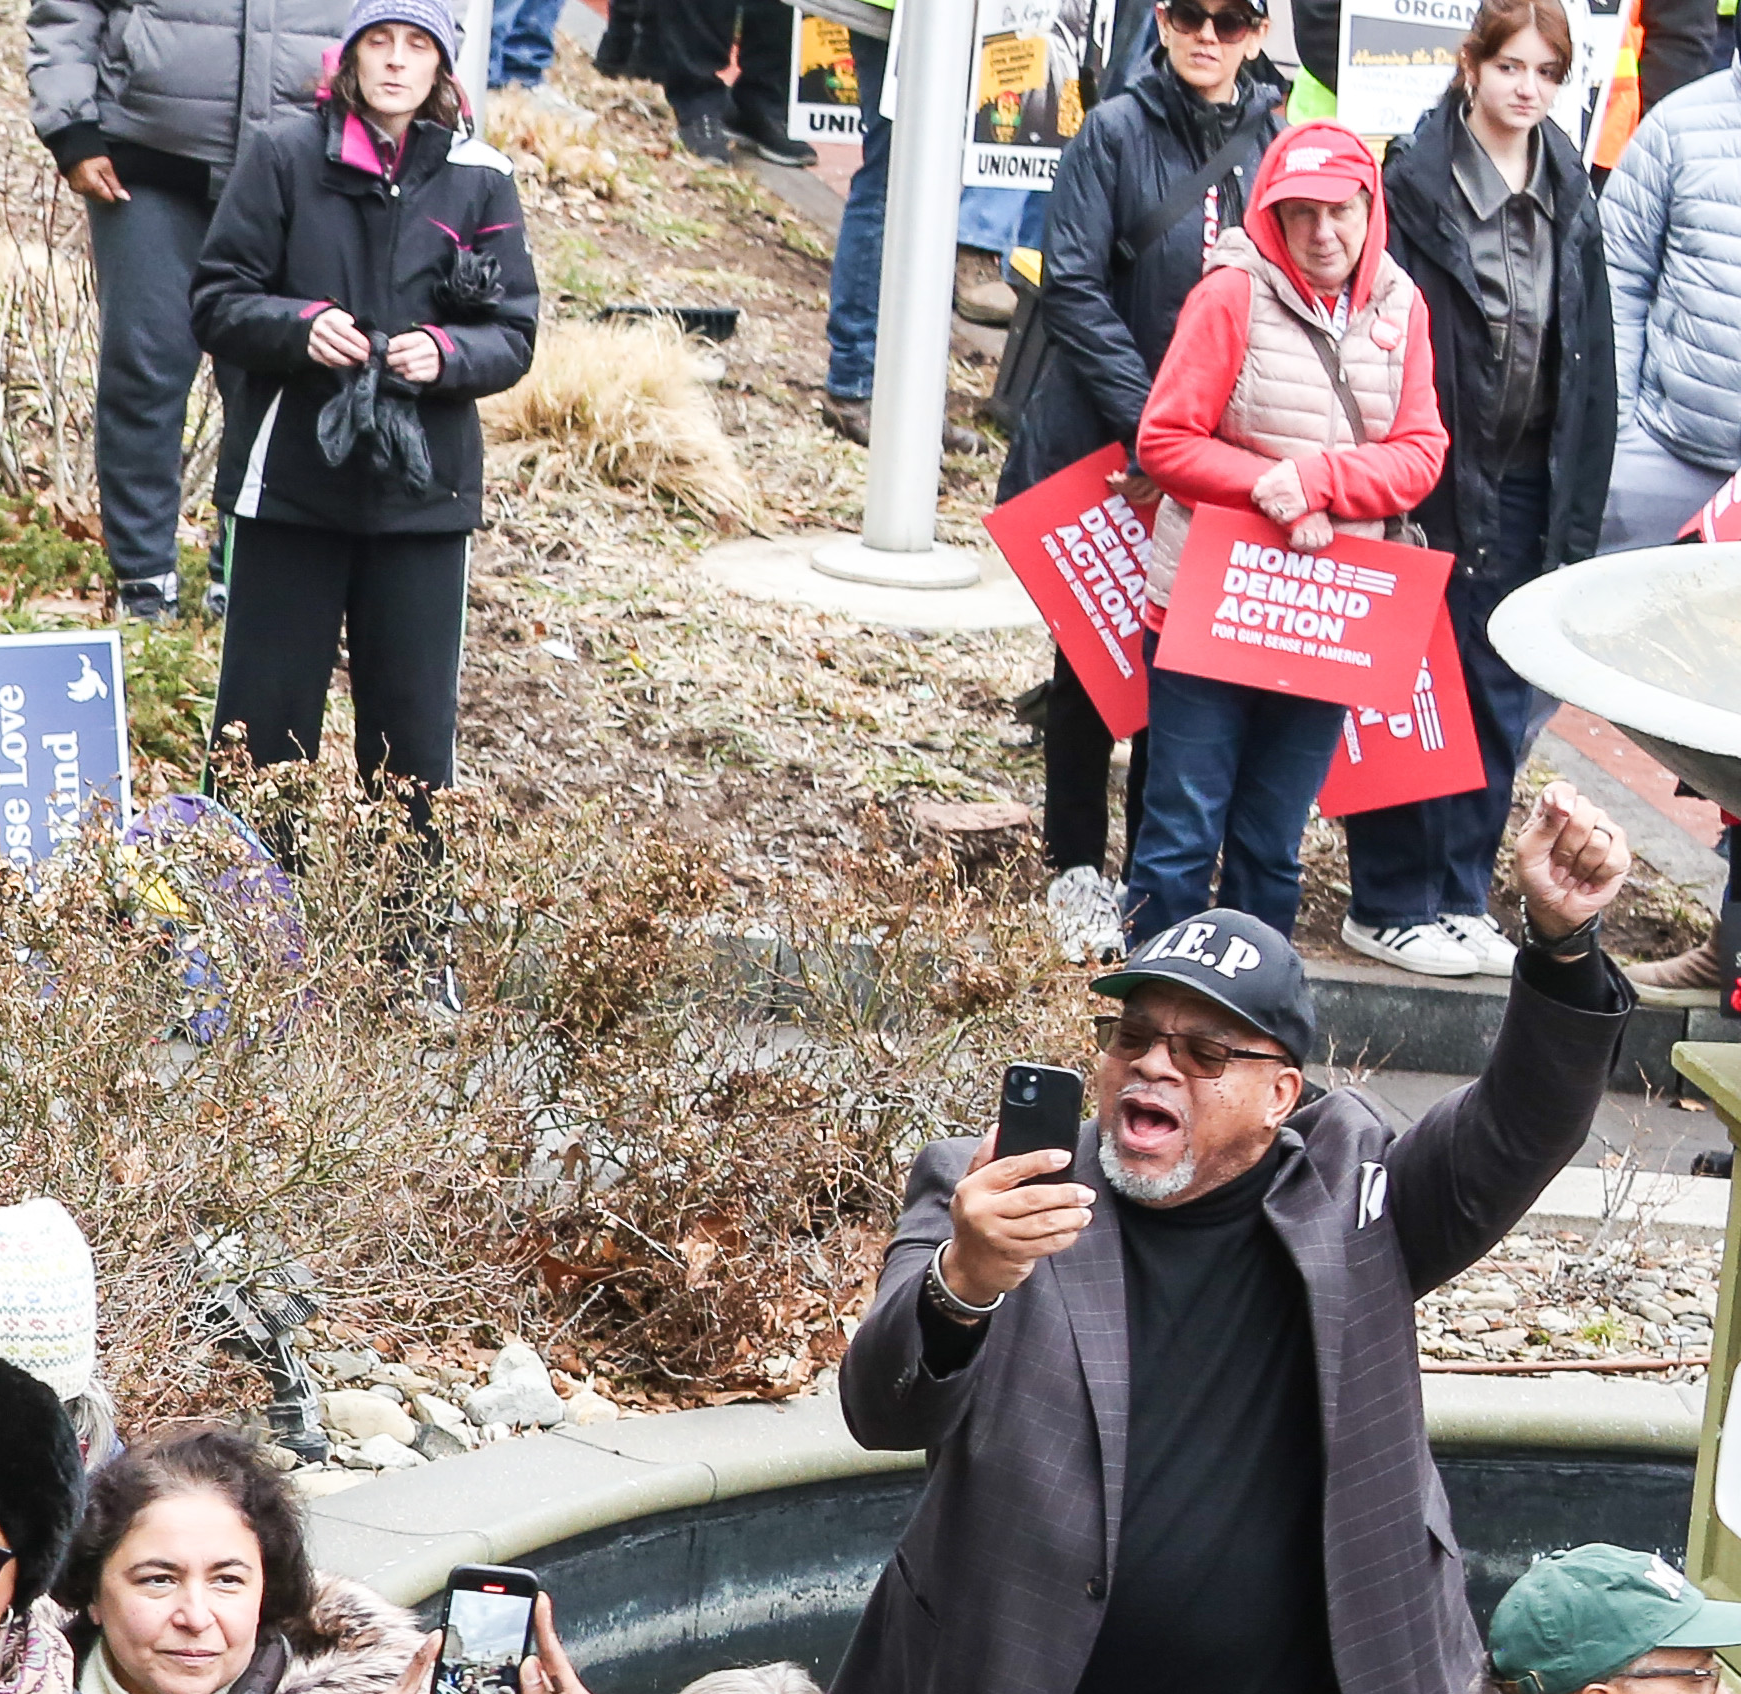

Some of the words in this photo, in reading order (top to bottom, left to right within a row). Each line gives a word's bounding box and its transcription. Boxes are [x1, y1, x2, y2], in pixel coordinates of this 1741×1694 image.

[1054, 523, 1141, 639] ACTION
[1229, 540, 1337, 585] MOMS
[1222, 567, 1371, 619] DEMAND
[1214, 595, 1346, 643] ACTION
[1211, 622, 1236, 640] FOR
[1237, 628, 1263, 646] GUN
[1264, 632, 1303, 655] SENSE
[1303, 641, 1317, 657] IN
[1318, 645, 1372, 668] AMERICA
